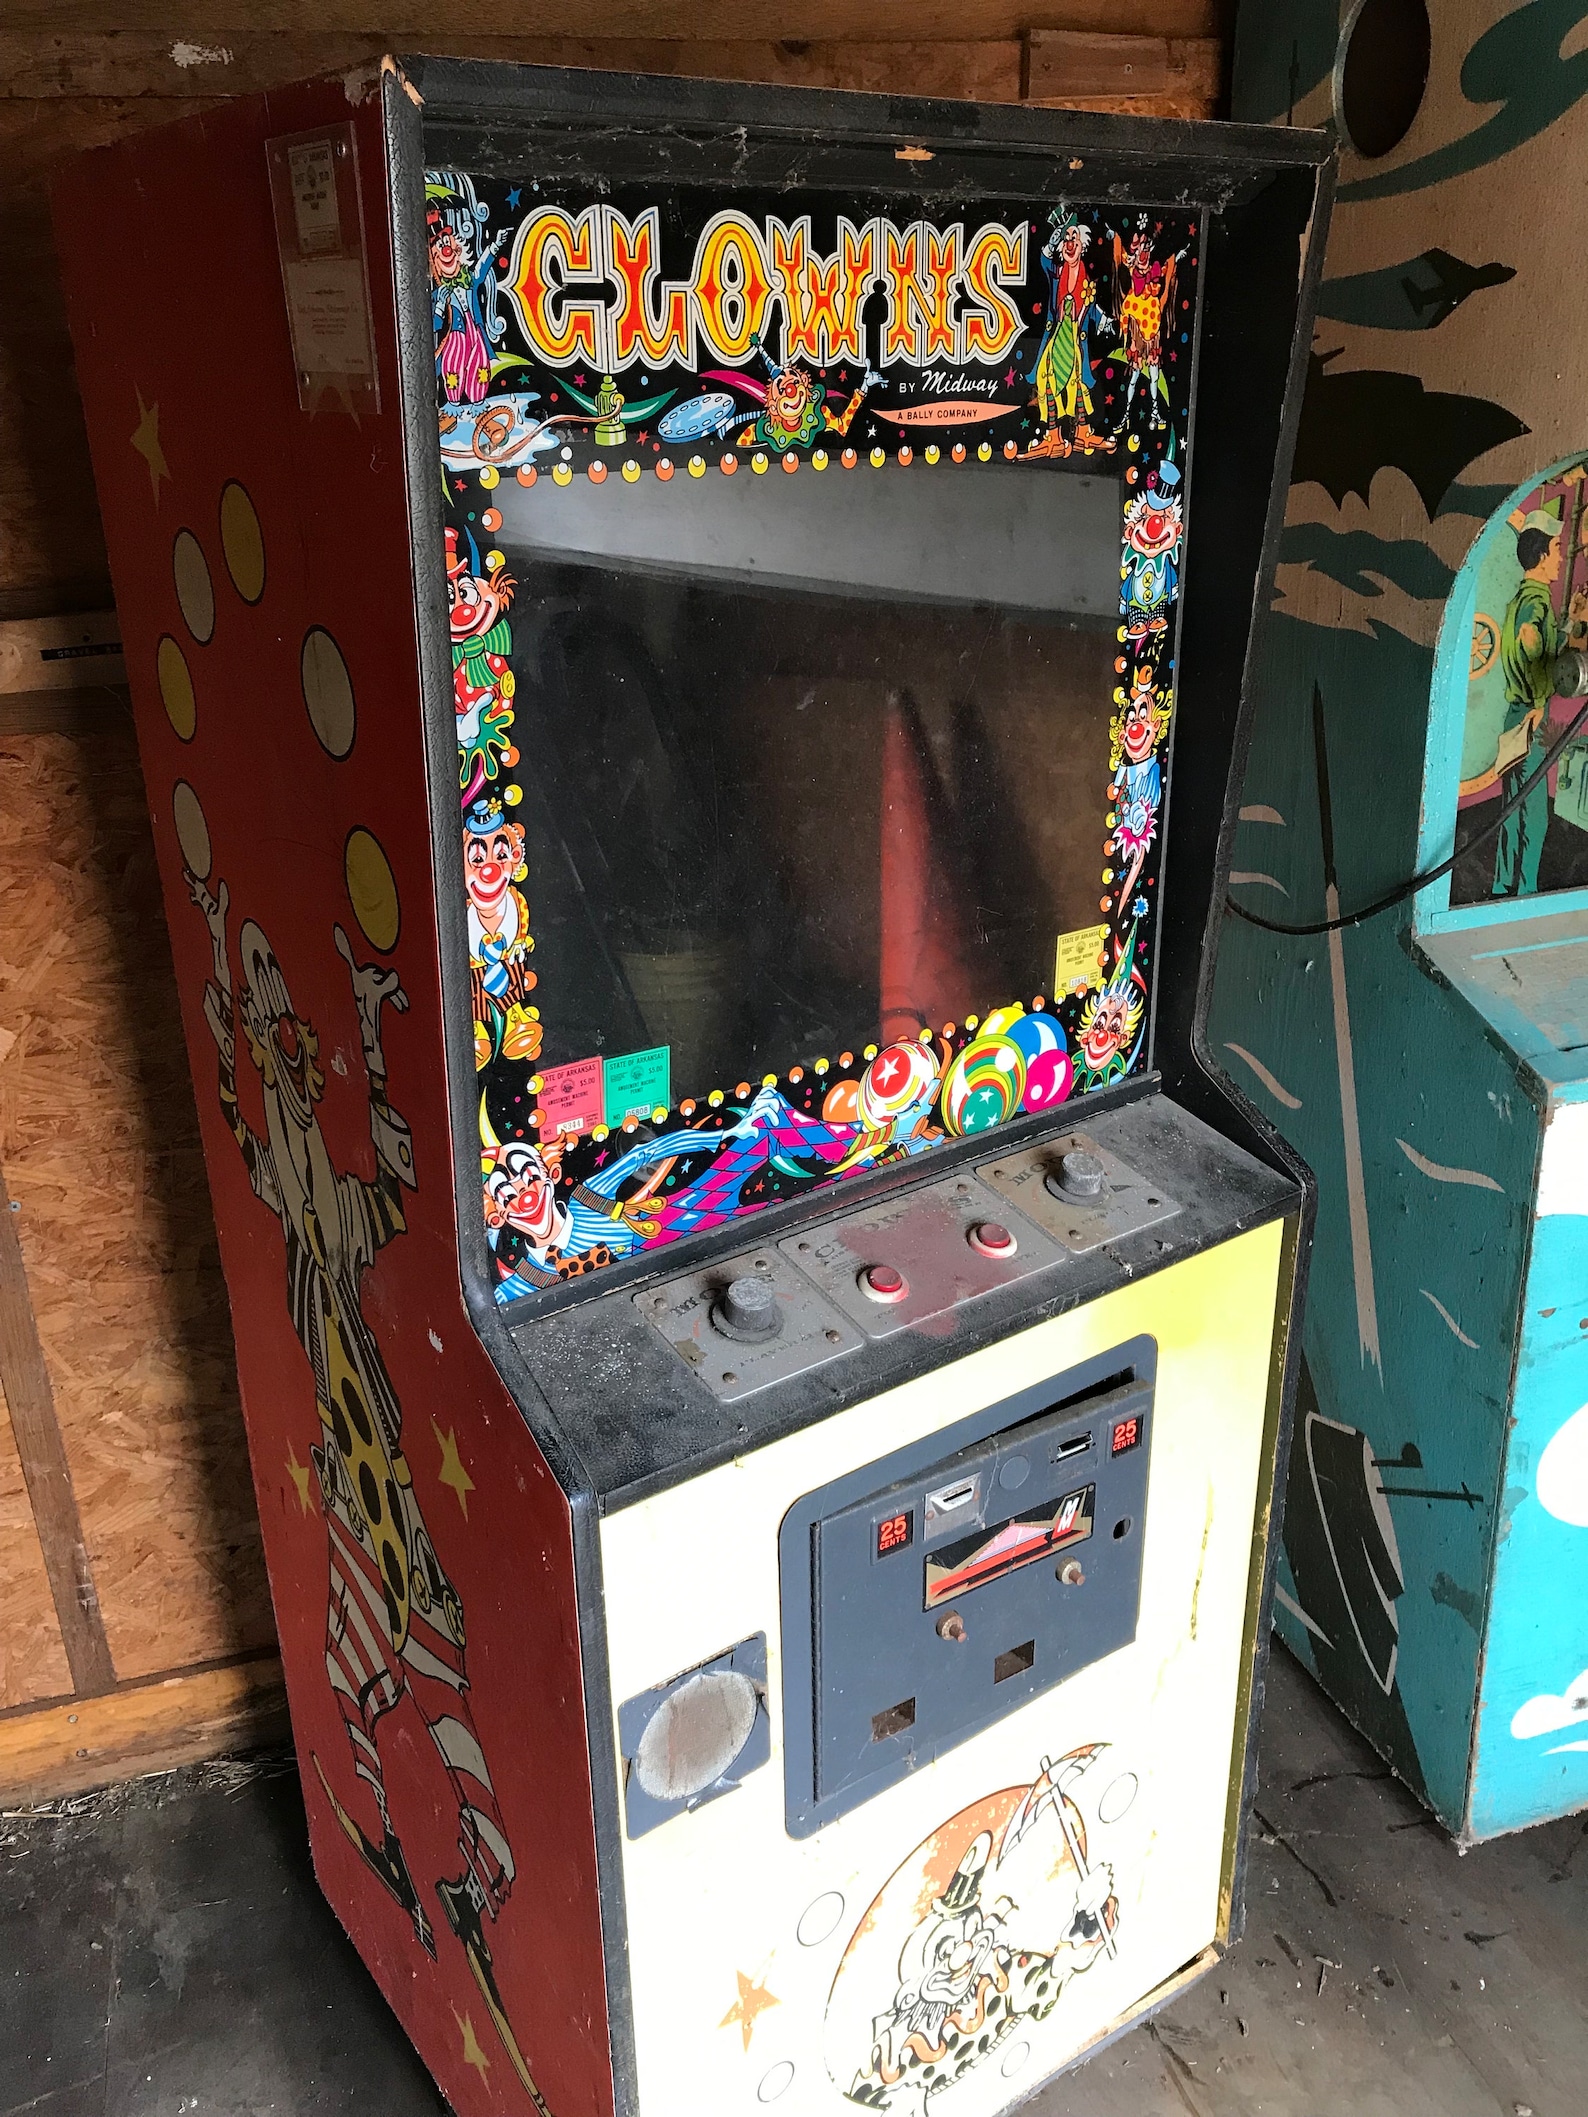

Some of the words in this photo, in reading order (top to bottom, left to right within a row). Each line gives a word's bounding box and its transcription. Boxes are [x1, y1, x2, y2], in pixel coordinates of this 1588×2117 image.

[497, 204, 1029, 374] CLOWNS
[899, 382, 916, 393] BY
[921, 369, 999, 398] Midway
[897, 411, 903, 420] A
[907, 409, 934, 420] BALLY
[937, 409, 978, 419] COMPANY
[609, 1060, 626, 1071] STATE
[636, 1052, 665, 1065] ARKANSAS
[648, 1065, 664, 1074] $5.00
[557, 1071, 565, 1079] OF
[566, 1063, 597, 1077] ARKANSAS
[580, 1077, 596, 1087] $5.00
[1114, 1419, 1137, 1443] 25
[1112, 1436, 1136, 1452] CENTS
[881, 1515, 907, 1542] 25
[879, 1533, 907, 1551] CENTS
